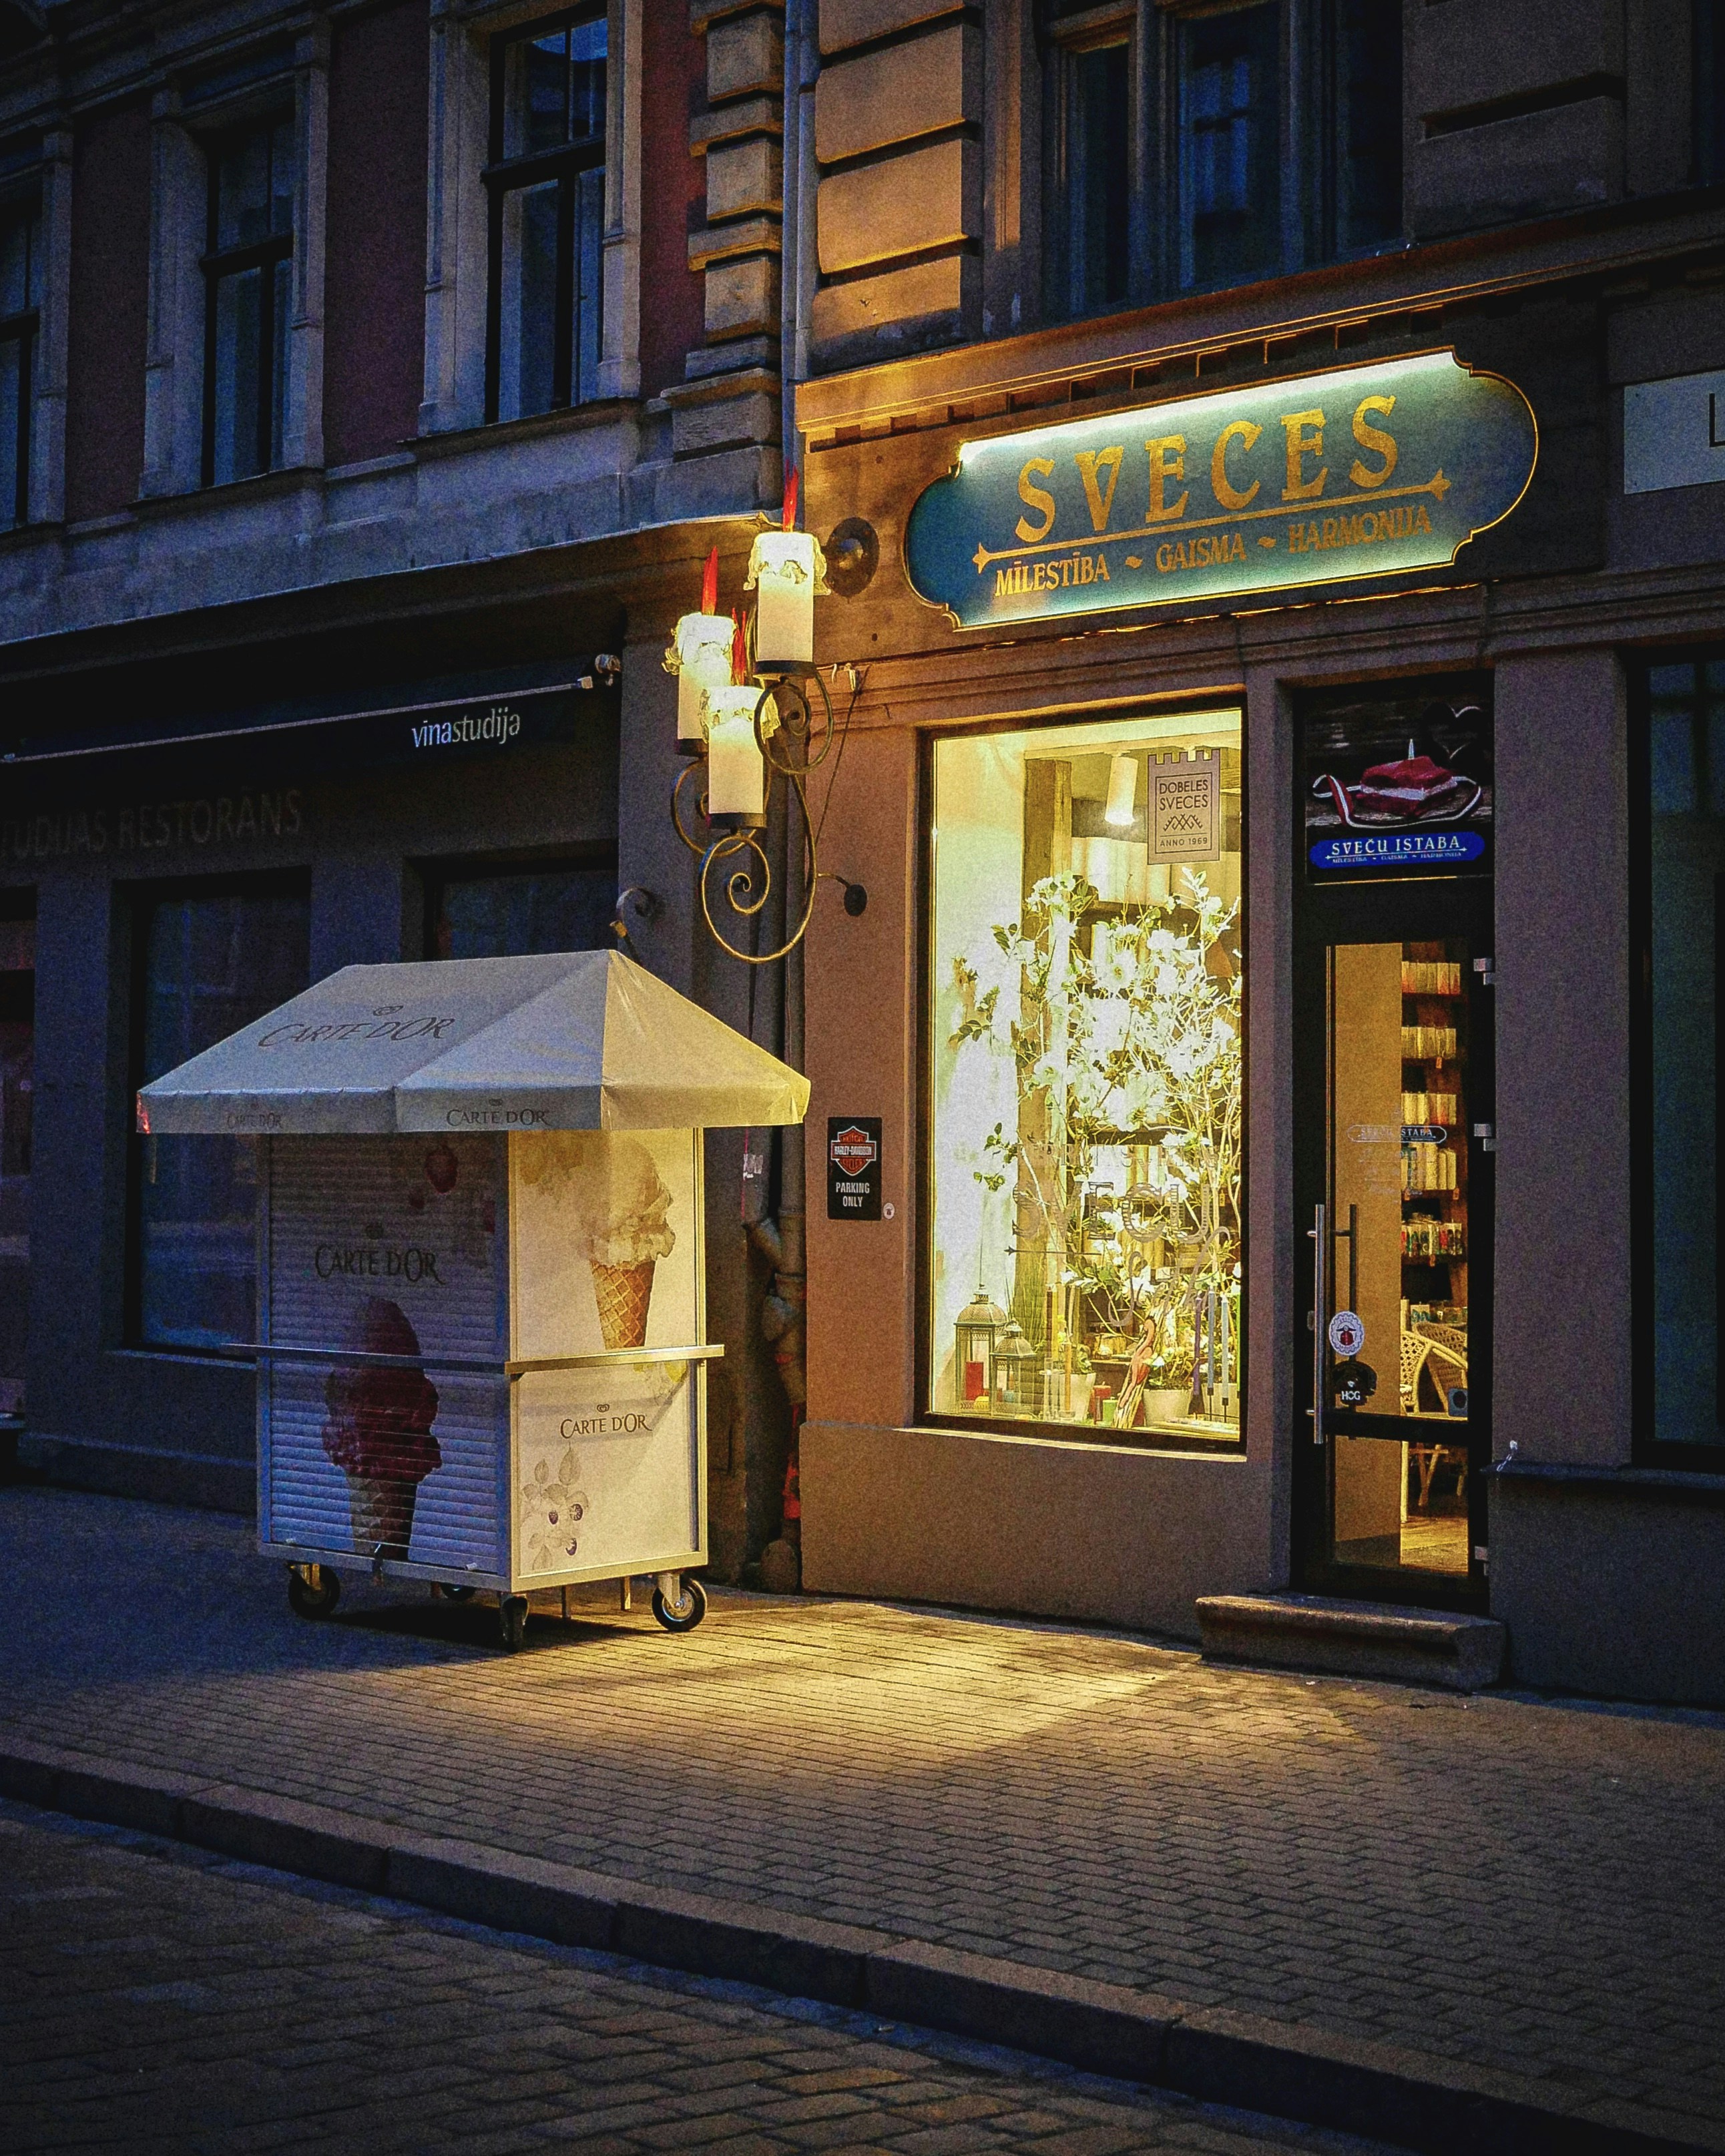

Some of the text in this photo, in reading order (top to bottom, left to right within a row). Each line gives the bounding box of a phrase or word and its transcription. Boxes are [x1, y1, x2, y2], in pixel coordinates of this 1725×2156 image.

[1015, 394, 1398, 543] SVECES
[994, 505, 1433, 597] MĪLESTĪBA GAISMA HARMONIJA
[411, 706, 521, 748] vīnastudija
[1159, 780, 1208, 795] DOBELES
[1159, 794, 1208, 811] SVECES
[1160, 837, 1208, 847] ANNO 1969
[1332, 836, 1460, 856] SVEČU ISTABA
[258, 1023, 373, 1047] CARTE
[446, 1109, 500, 1127] CARTE
[836, 1181, 871, 1193] PARKING
[842, 1195, 863, 1207] ONLY
[314, 1244, 379, 1278] CARTE
[560, 1413, 653, 1439] CARTE D'OR
